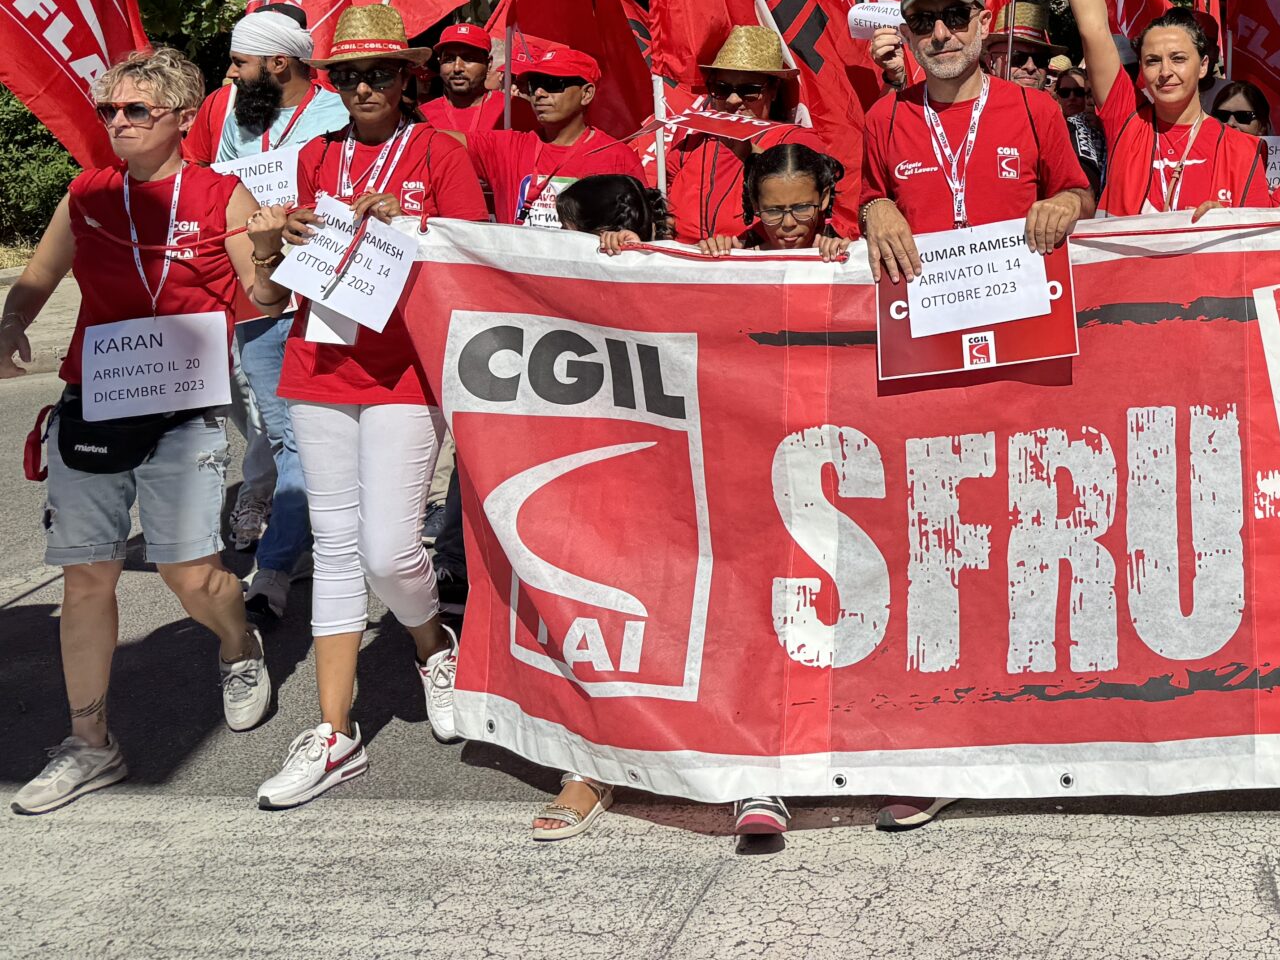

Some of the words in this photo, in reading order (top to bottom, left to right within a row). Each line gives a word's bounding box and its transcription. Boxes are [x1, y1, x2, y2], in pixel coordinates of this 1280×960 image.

[857, 4, 900, 17] ARRIVATO
[997, 147, 1019, 155] CGIL
[221, 160, 284, 178] TINDER
[278, 180, 289, 189] 02
[402, 181, 425, 189] CGIL
[311, 232, 363, 264] ARRIVAO
[363, 257, 373, 270] IL
[377, 265, 391, 278] 14
[363, 231, 404, 260] RAMESH
[969, 235, 1026, 253] RAMESH
[296, 251, 348, 283] OTTOBE
[347, 275, 375, 296] 2023
[919, 264, 984, 287] ARRIVATO
[987, 262, 998, 274] IL
[1005, 258, 1021, 271] 14
[921, 287, 981, 309] OTTOBRE
[985, 281, 1017, 297] 2023
[93, 332, 163, 355] KARAN
[968, 336, 988, 344] CGIL
[93, 362, 164, 381] ARRIVATO
[168, 361, 178, 372] IL
[185, 358, 200, 369] 20
[457, 324, 687, 420] CGIL
[94, 383, 167, 403] DICEMBRE
[174, 379, 205, 394] 2023
[74, 444, 108, 454] mistral
[538, 616, 645, 673] AI
